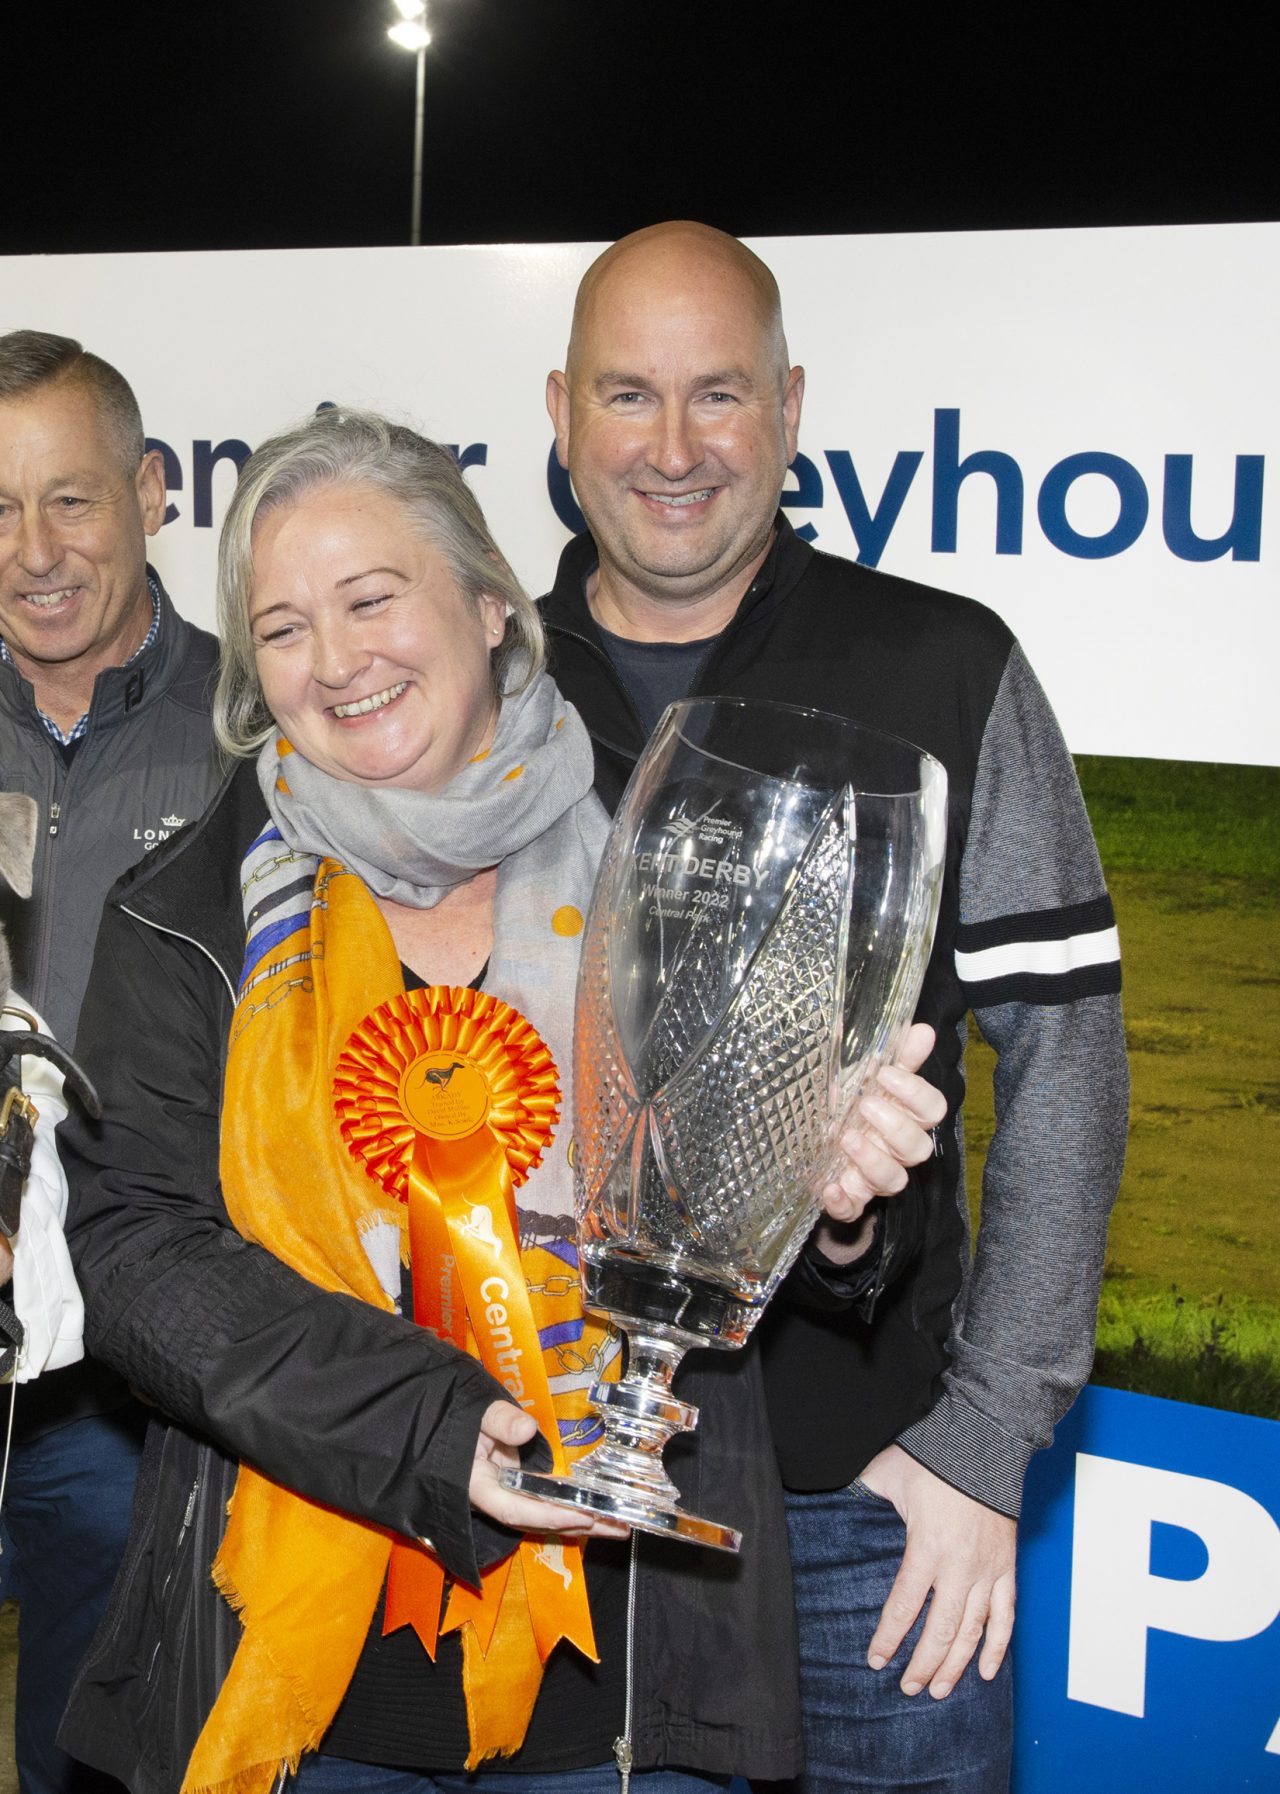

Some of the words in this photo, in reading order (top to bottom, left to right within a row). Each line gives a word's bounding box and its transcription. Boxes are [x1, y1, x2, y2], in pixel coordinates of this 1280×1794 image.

[703, 816, 732, 827] Premier
[133, 829, 175, 841] LON
[700, 824, 743, 838] Greyhound
[699, 832, 724, 845] Racing
[683, 856, 770, 890] DERBY
[643, 883, 689, 901] Winner
[692, 890, 729, 909] 2022
[649, 905, 685, 919] Central
[439, 1254, 456, 1333] Premier
